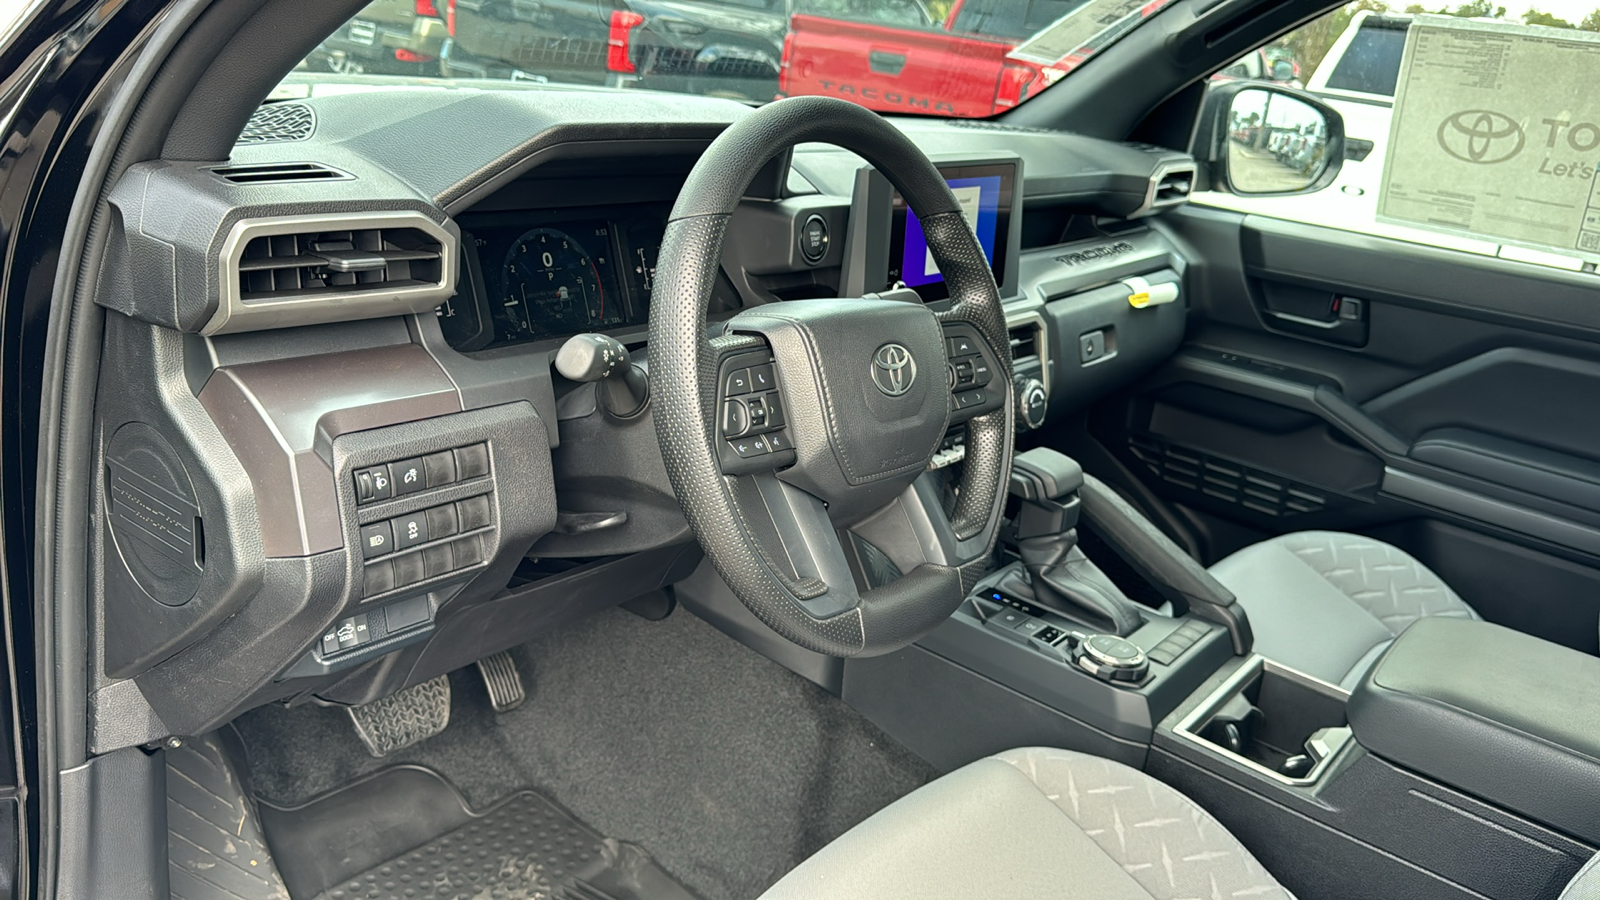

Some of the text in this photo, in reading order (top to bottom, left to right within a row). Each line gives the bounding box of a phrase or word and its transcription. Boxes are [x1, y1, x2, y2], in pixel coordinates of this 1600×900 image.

[818, 79, 954, 113] TACOMA
[1538, 157, 1594, 180] Let's
[541, 235, 546, 243] 4
[521, 244, 527, 253] 3
[562, 241, 568, 249] 5
[542, 252, 553, 268] 0
[580, 258, 586, 266] 6
[510, 265, 516, 273] 2
[548, 272, 554, 281] P
[591, 284, 596, 292] 7
[591, 309, 596, 317] 8
[521, 321, 527, 329] 0
[357, 623, 367, 632] ON
[324, 632, 336, 642] OFF
